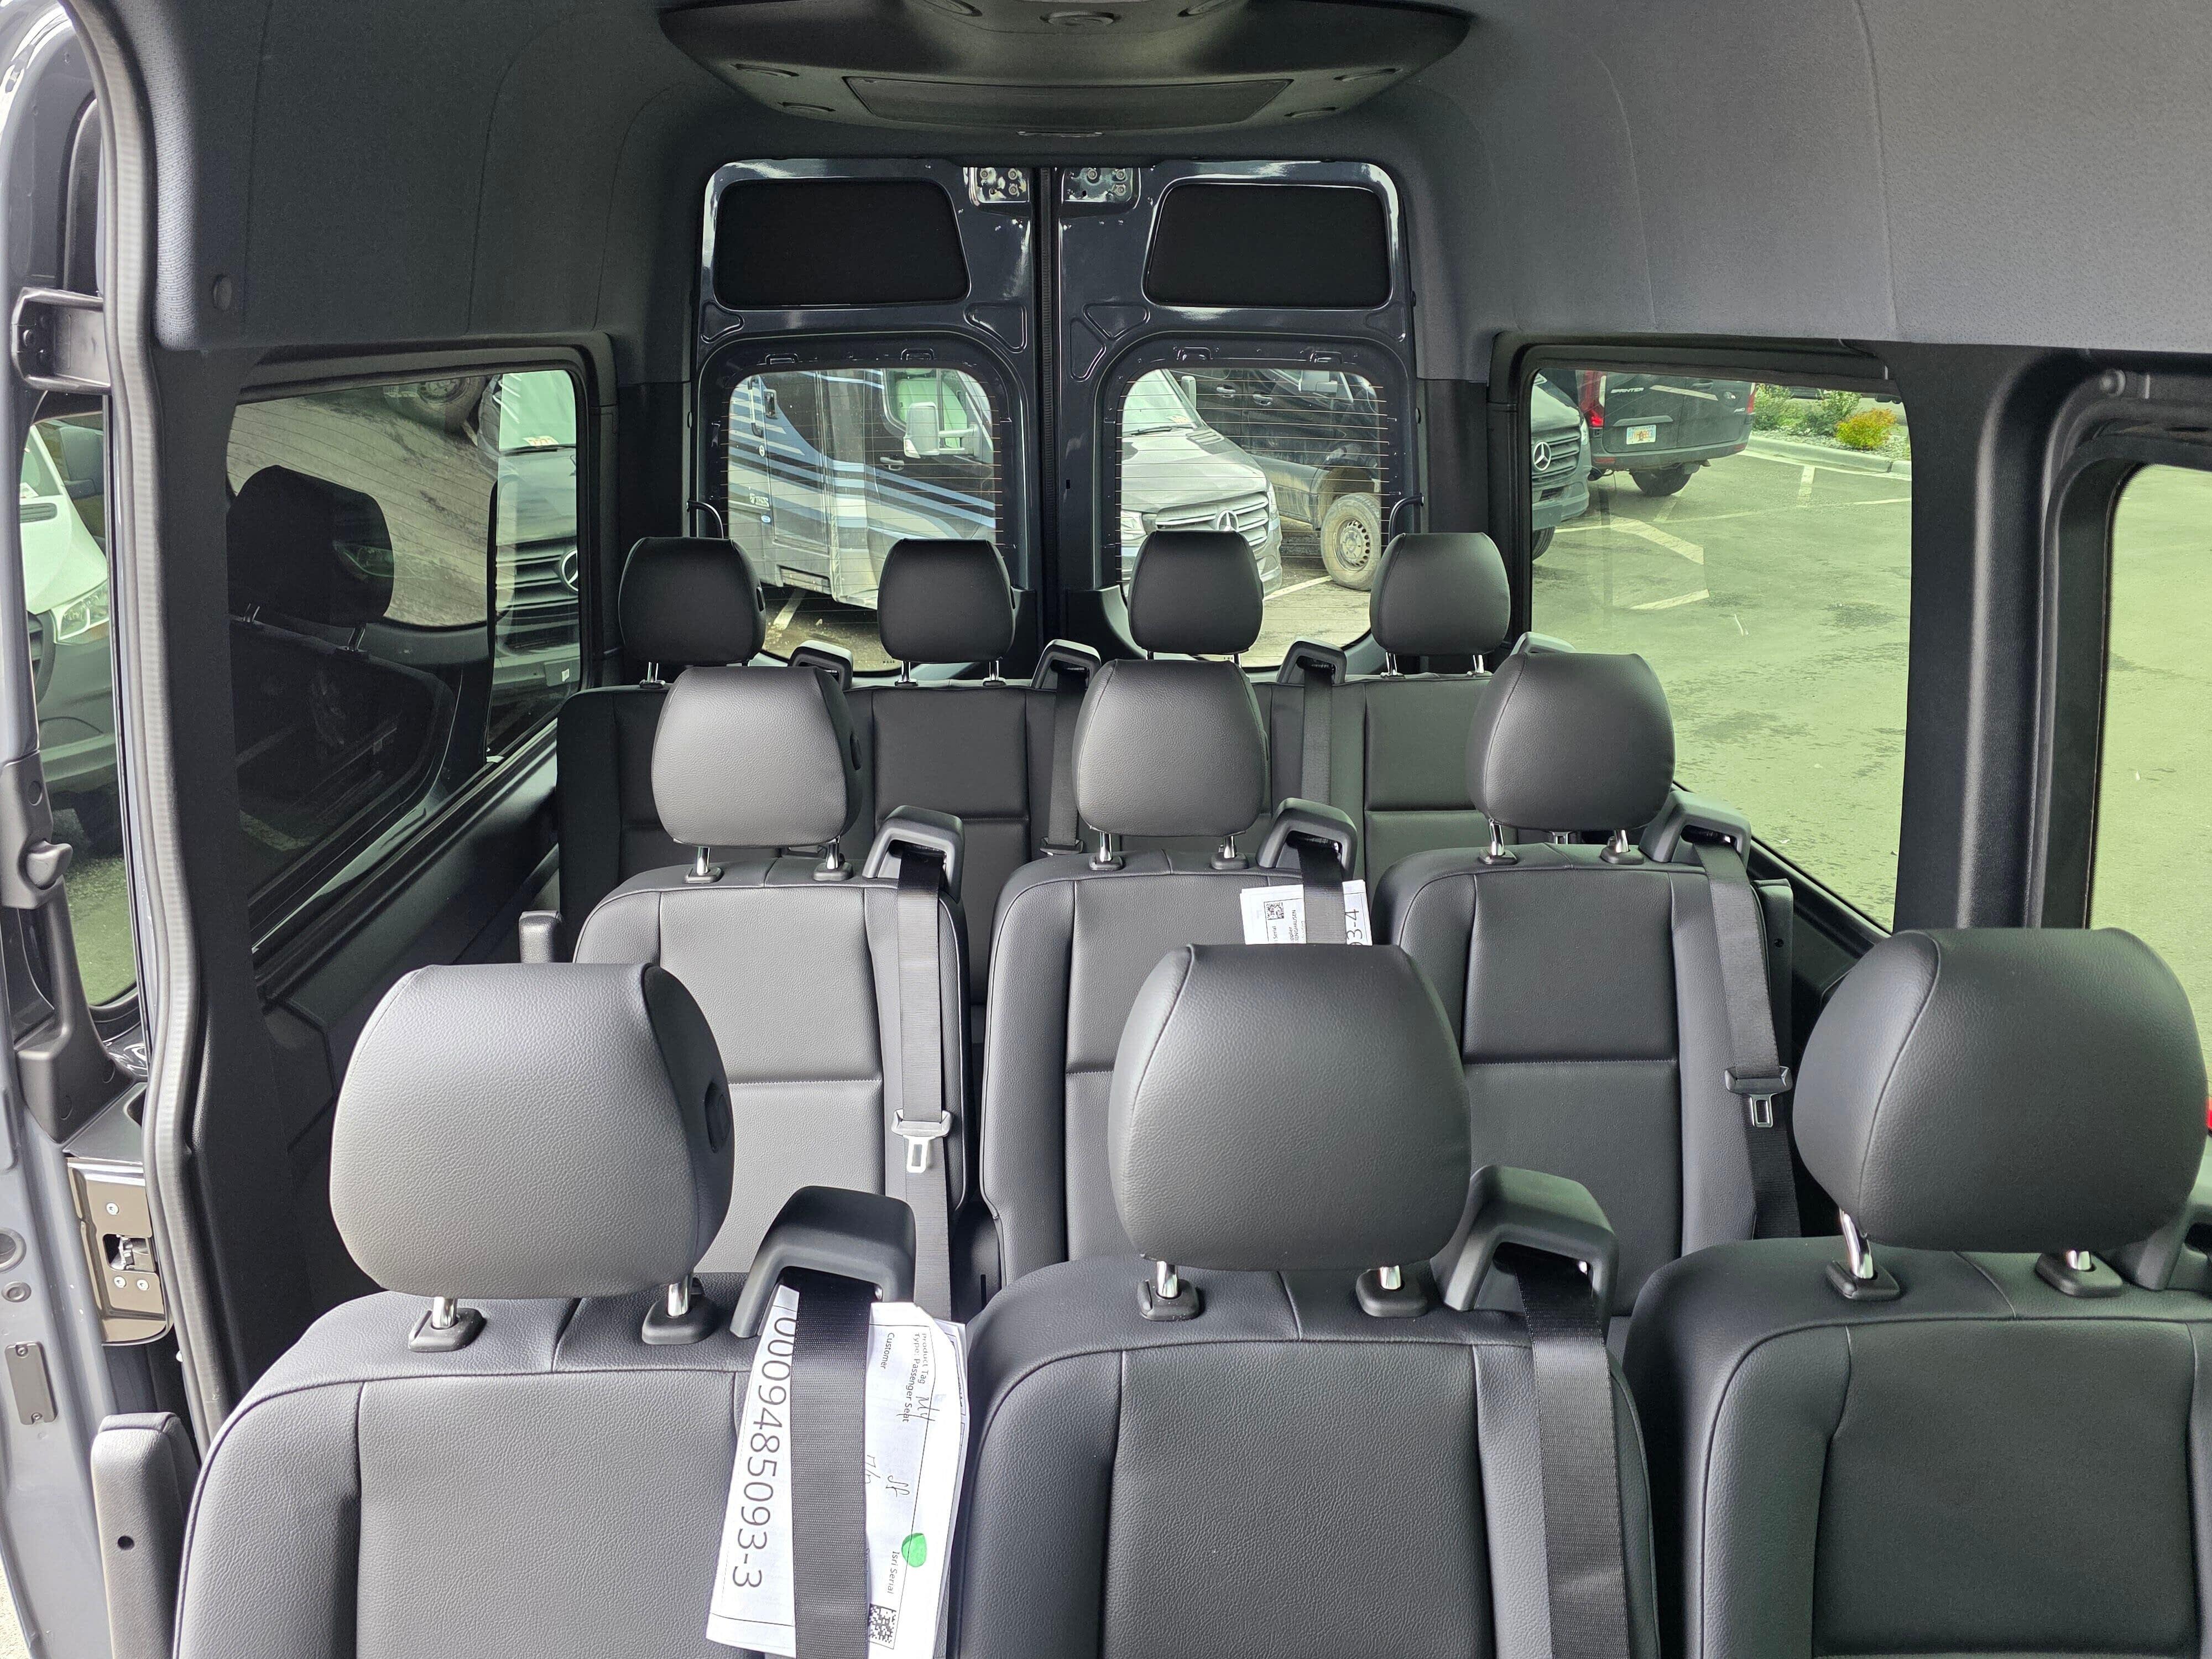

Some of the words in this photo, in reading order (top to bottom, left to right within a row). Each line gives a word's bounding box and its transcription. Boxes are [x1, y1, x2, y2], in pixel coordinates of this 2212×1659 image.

[880, 1332, 895, 1369] Customer
[906, 1359, 920, 1401] Passenger
[918, 1370, 928, 1384] Tag
[902, 1402, 912, 1422] Seat
[732, 1317, 796, 1588] 0009485093-3
[891, 1551, 900, 1566] Isri
[887, 1568, 898, 1594] Serial
